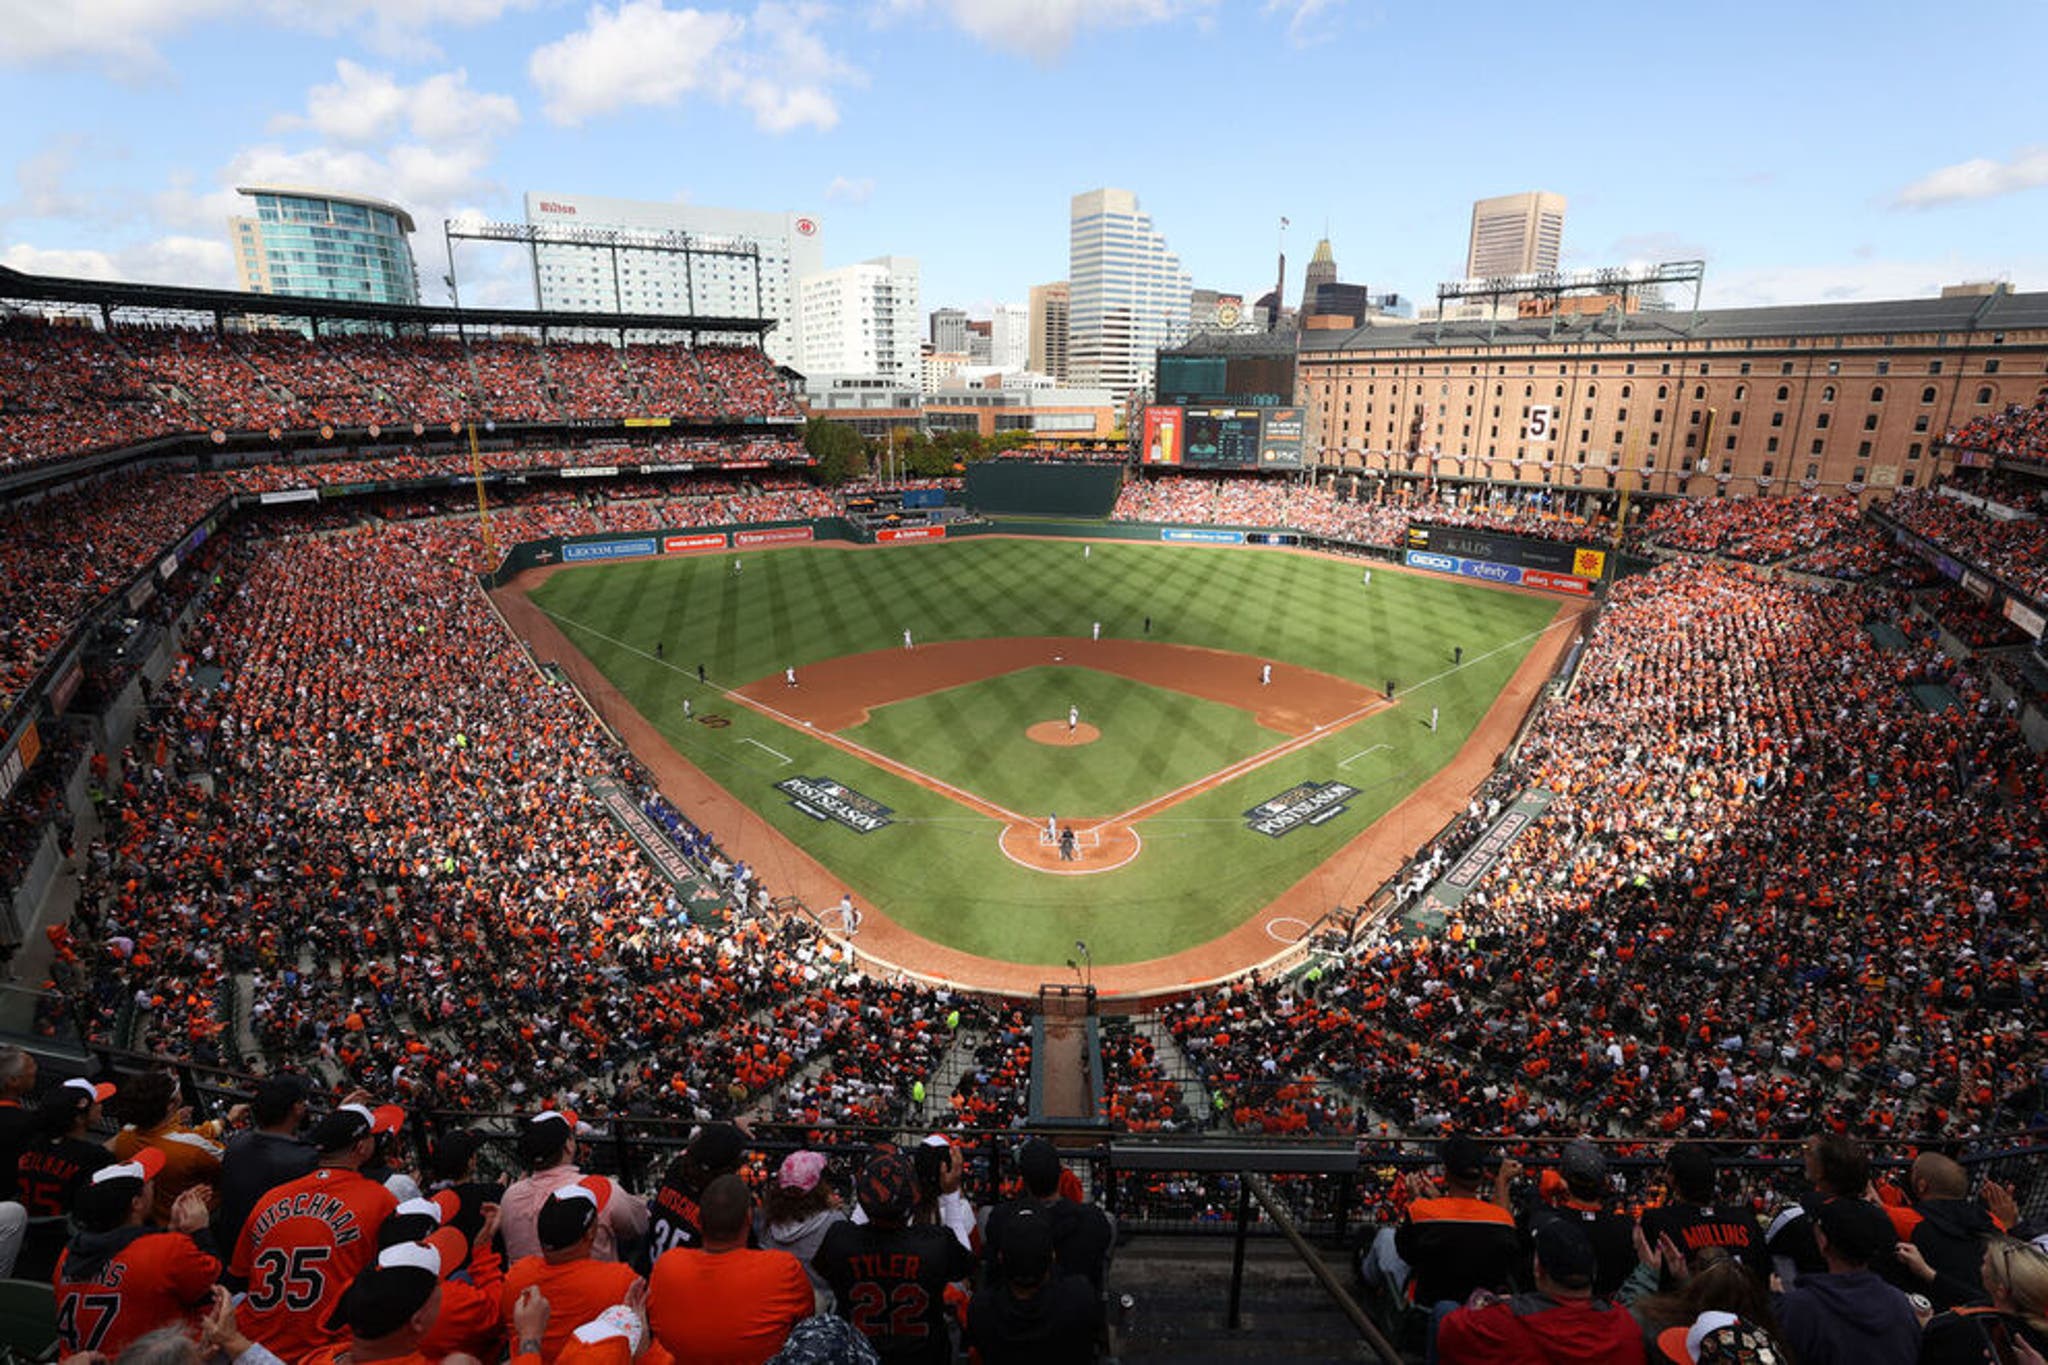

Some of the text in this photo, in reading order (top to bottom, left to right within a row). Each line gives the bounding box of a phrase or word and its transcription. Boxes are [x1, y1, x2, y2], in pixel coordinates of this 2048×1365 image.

[539, 201, 576, 215] Hilton
[1530, 409, 1547, 436] 5
[1411, 554, 1452, 570] GEICO
[248, 1246, 331, 1312] 35
[847, 1252, 922, 1279] TYLER
[57, 1292, 122, 1351] 47
[849, 1282, 930, 1337] 22
